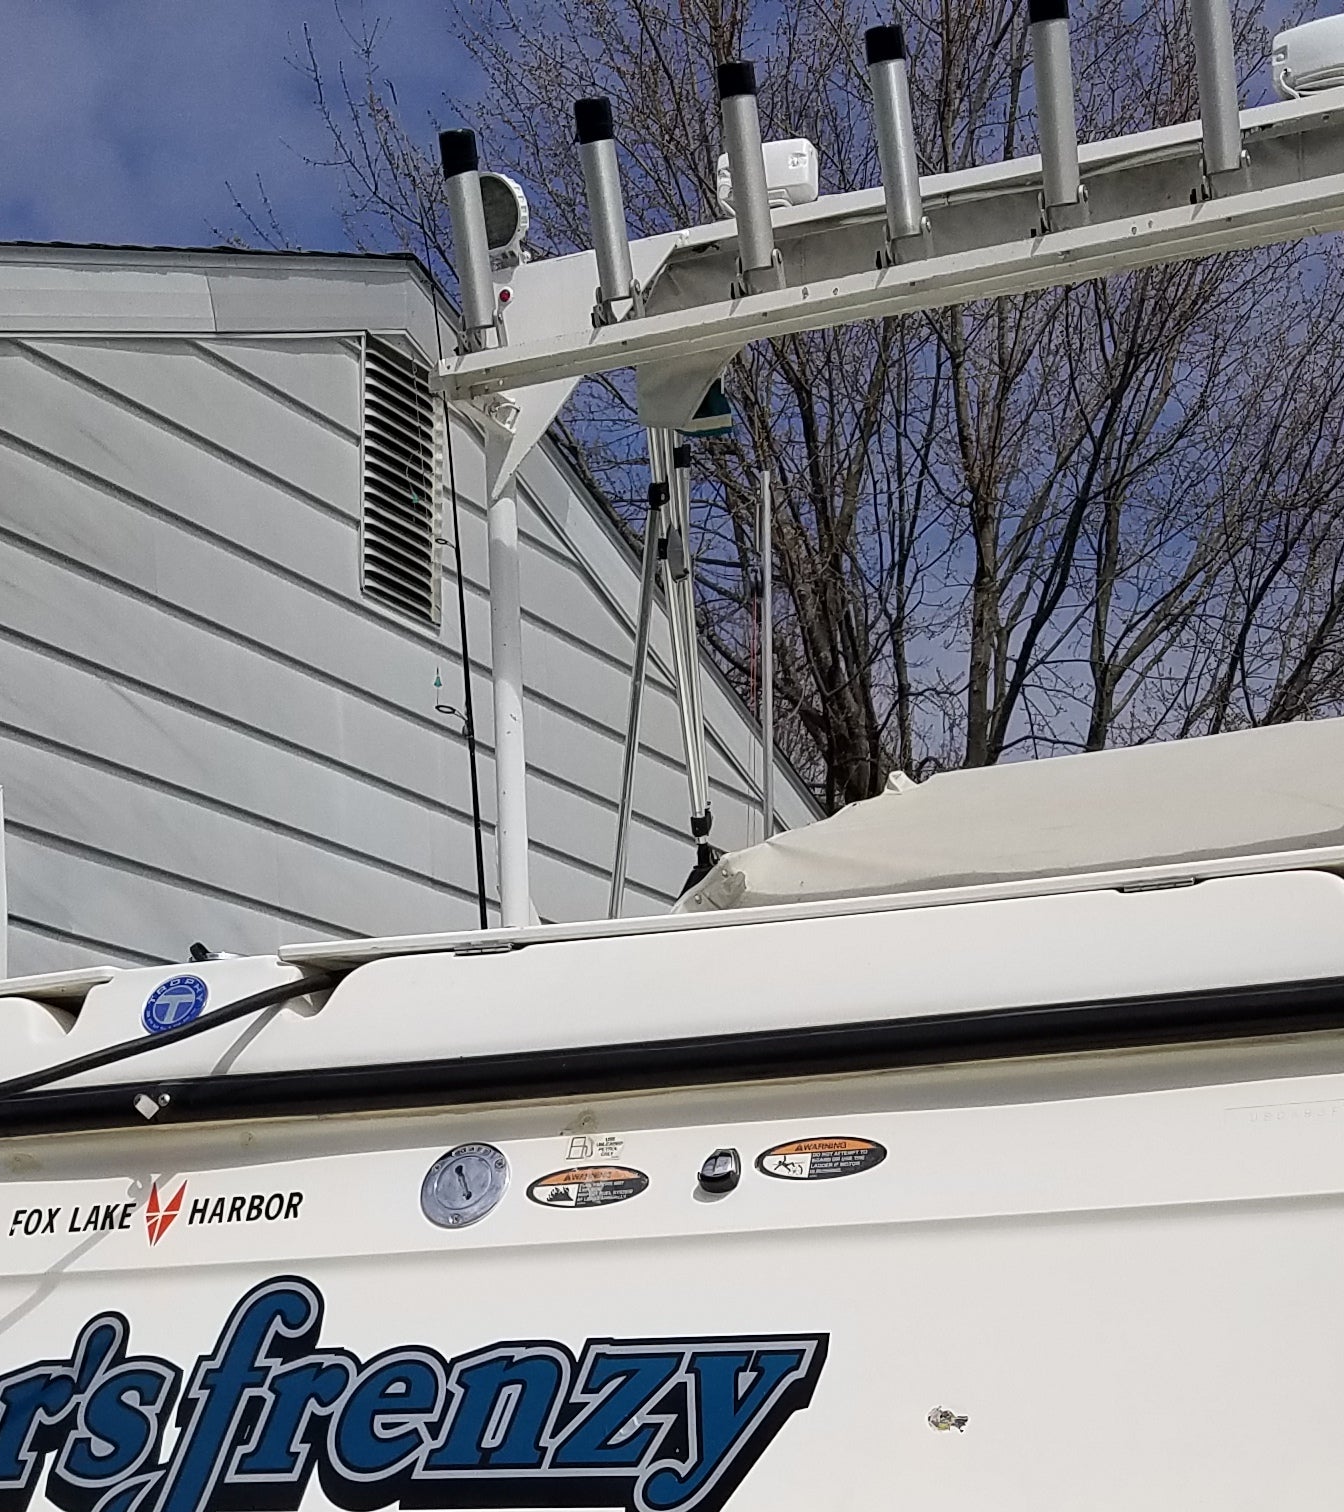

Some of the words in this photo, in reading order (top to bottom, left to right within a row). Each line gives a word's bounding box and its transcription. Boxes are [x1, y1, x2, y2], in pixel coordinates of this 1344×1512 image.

[804, 1141, 847, 1151] WARNING
[8, 1207, 61, 1237] FOX
[68, 1202, 137, 1233] LAKE
[188, 1191, 304, 1225] HARBOR
